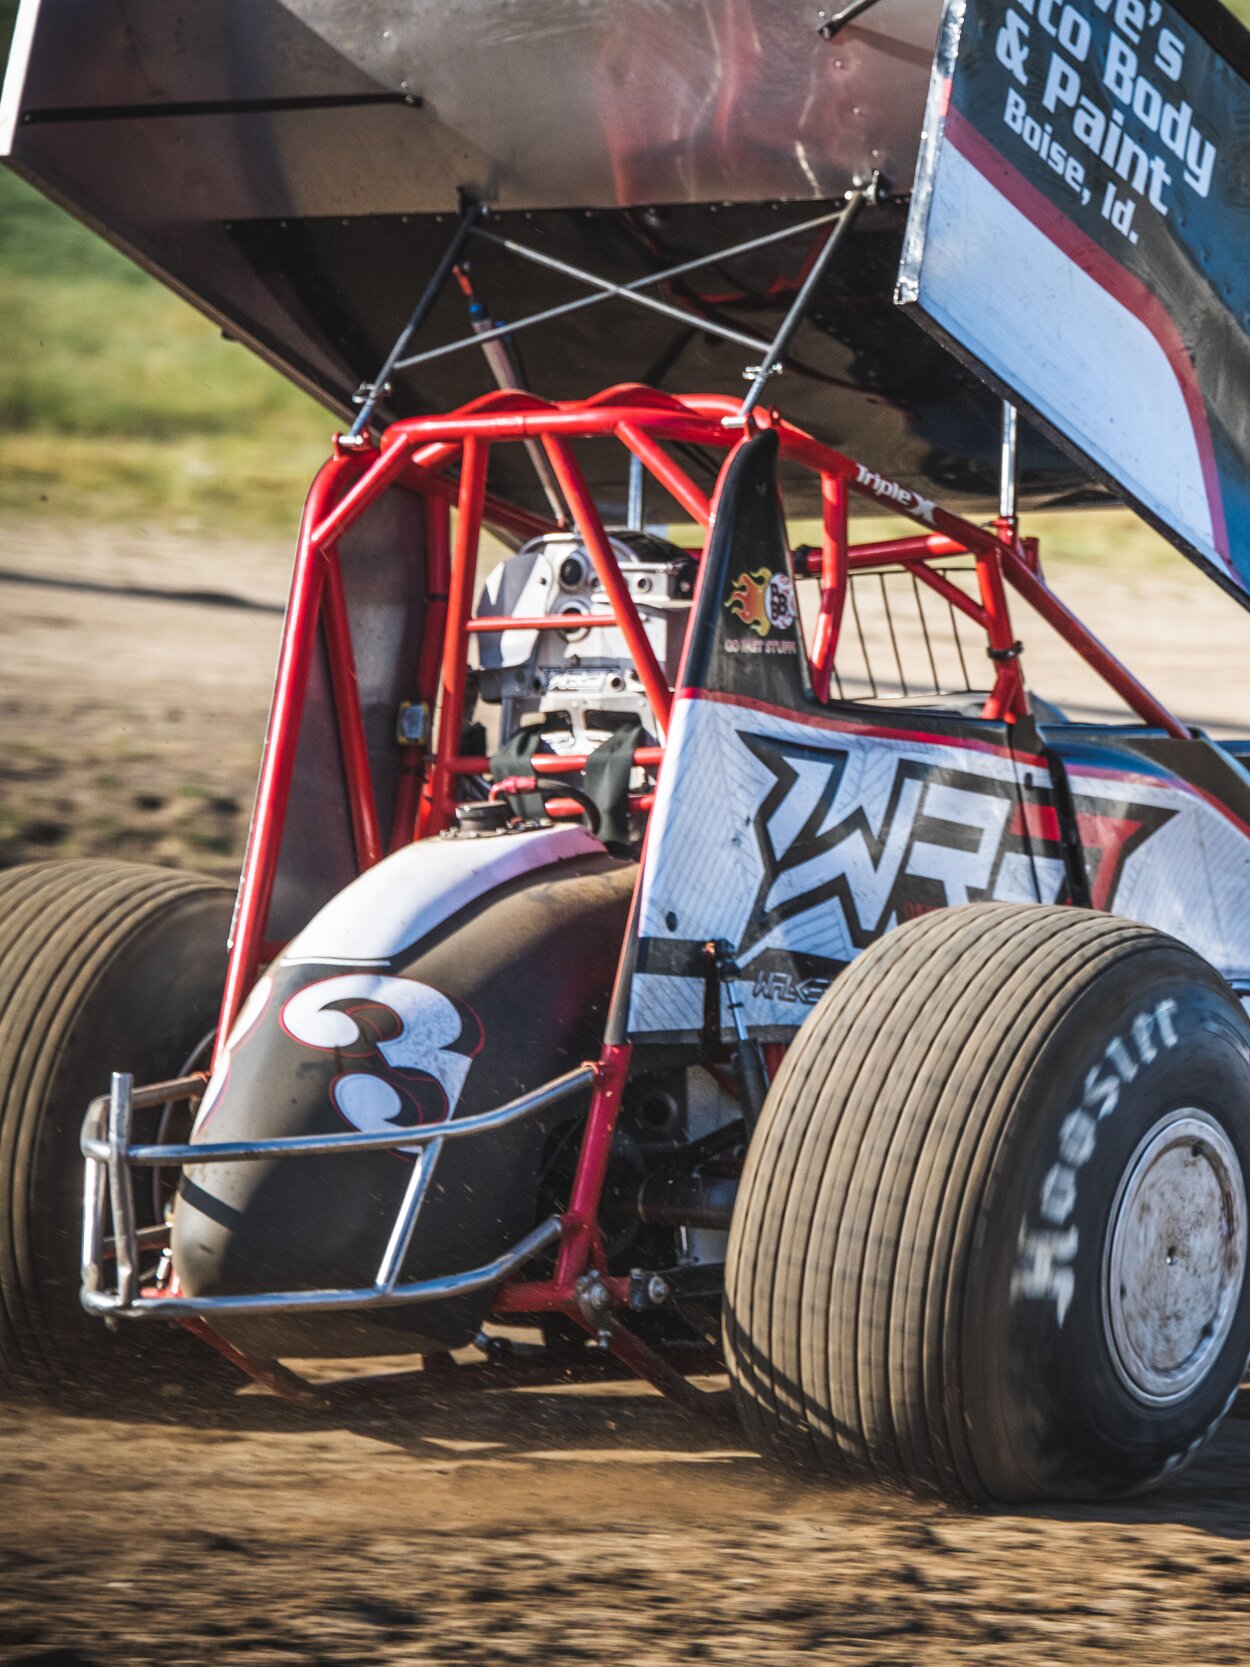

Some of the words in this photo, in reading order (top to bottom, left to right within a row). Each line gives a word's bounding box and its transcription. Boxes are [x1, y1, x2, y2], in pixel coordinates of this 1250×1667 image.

[996, 8, 1030, 86] &
[1042, 51, 1172, 216] Paint
[1003, 86, 1092, 206] Boise,
[1101, 181, 1139, 245] Id.
[1103, 31, 1216, 198] Body
[856, 462, 912, 506] Triple
[904, 491, 938, 526] X
[281, 973, 477, 1158] 3
[752, 969, 832, 1006] WALKE
